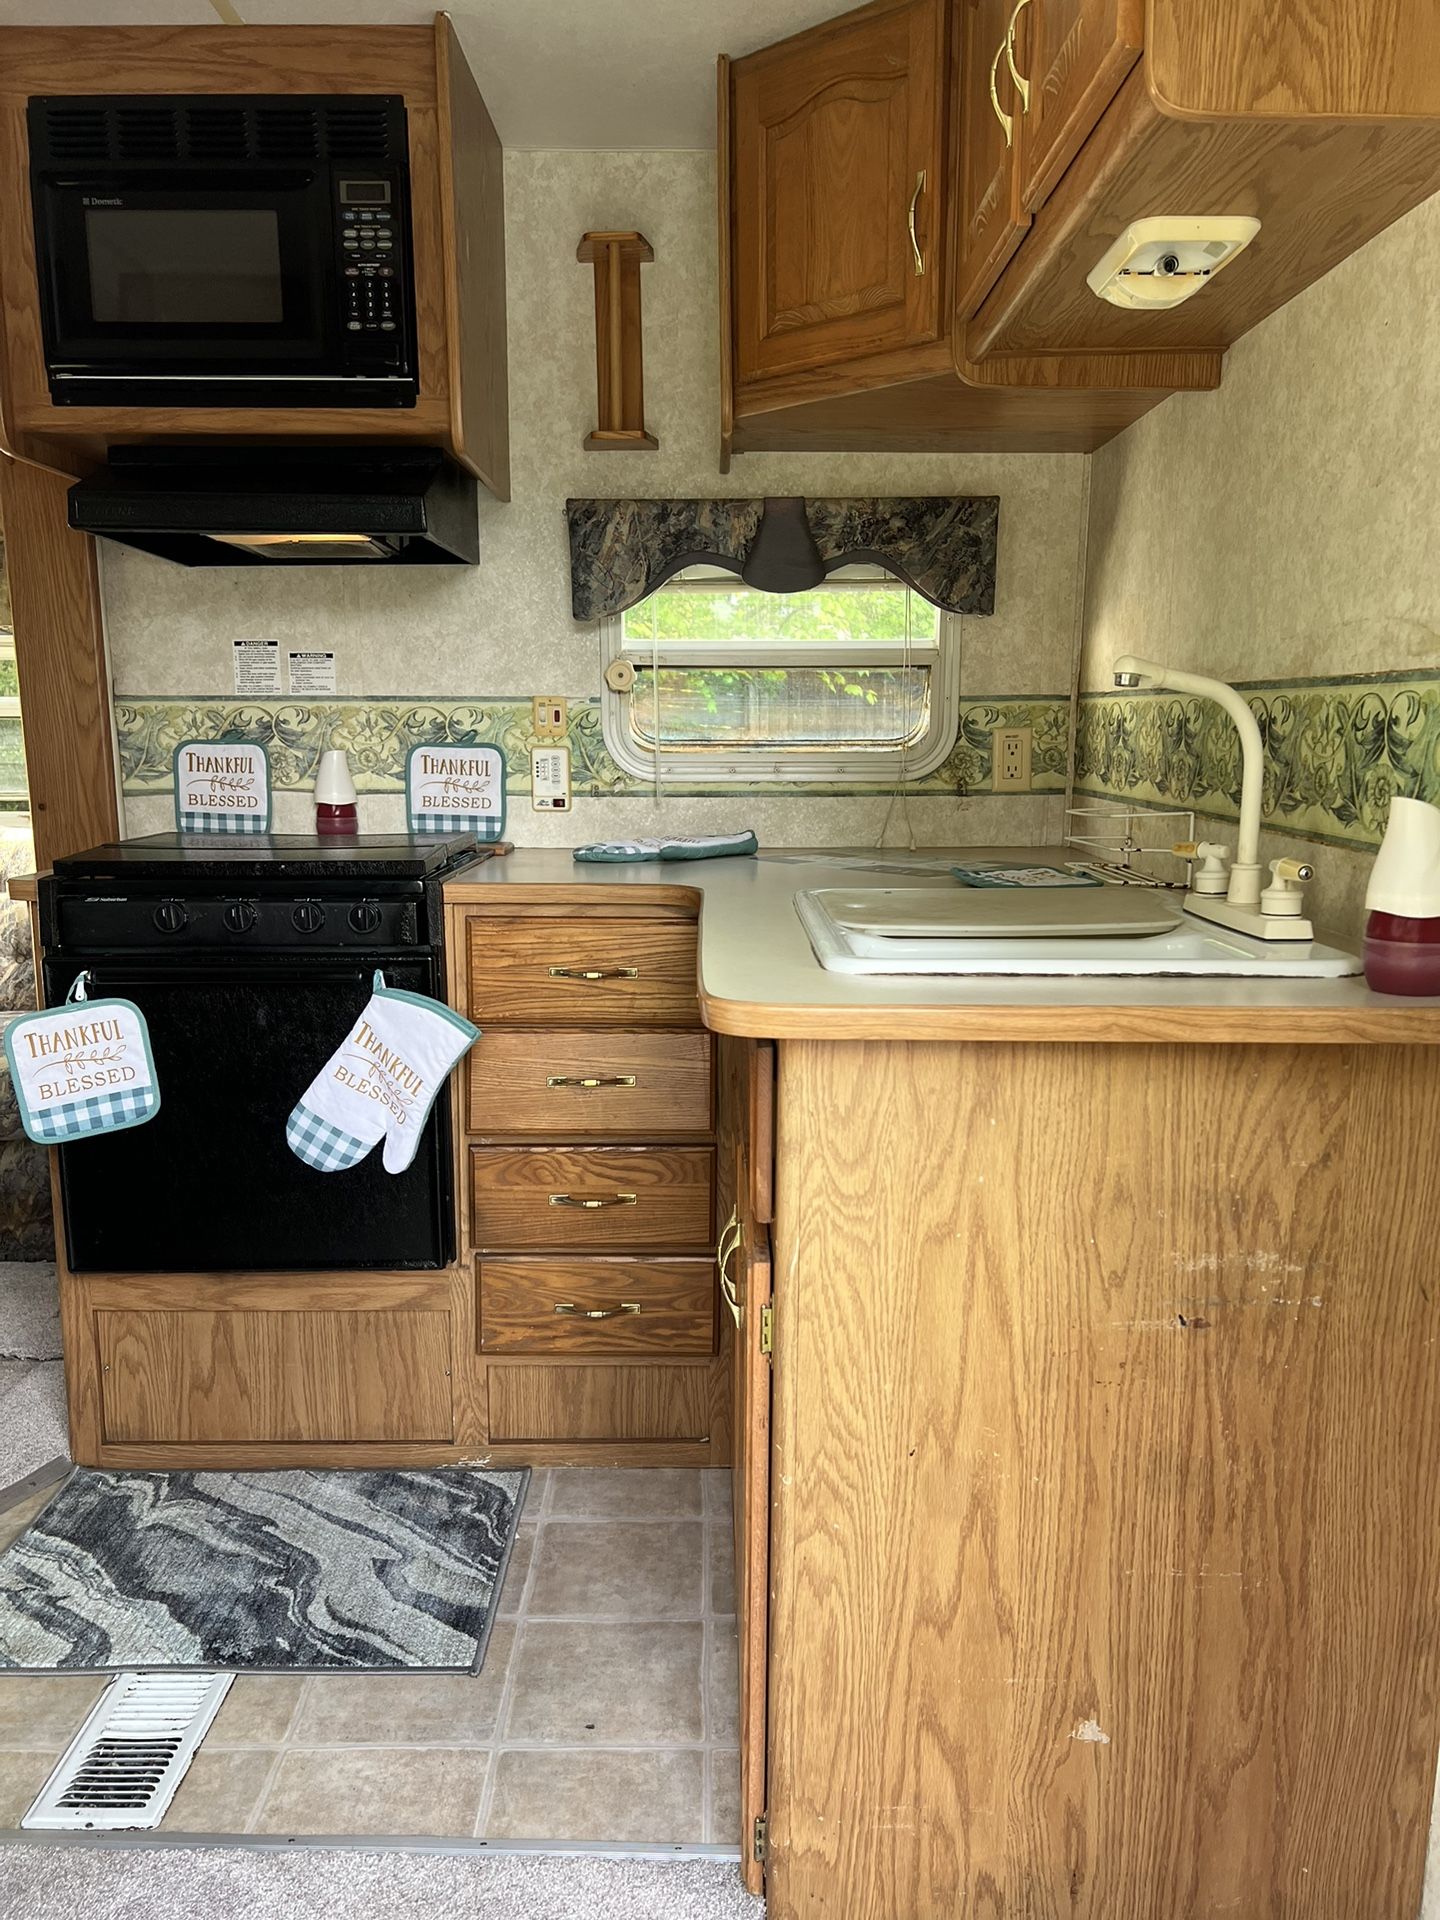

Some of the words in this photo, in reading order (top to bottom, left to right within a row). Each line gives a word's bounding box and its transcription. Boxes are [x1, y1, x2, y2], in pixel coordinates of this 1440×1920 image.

[185, 752, 255, 775] THANKFUL
[421, 754, 491, 777] THANKFUL
[188, 793, 258, 809] BLESSED
[422, 795, 492, 810] BLESSED
[24, 1019, 124, 1058] THANKFUL
[354, 1021, 424, 1098] THANKFUL
[40, 1066, 136, 1101] BLESSED
[333, 1065, 407, 1125] BLESSED
